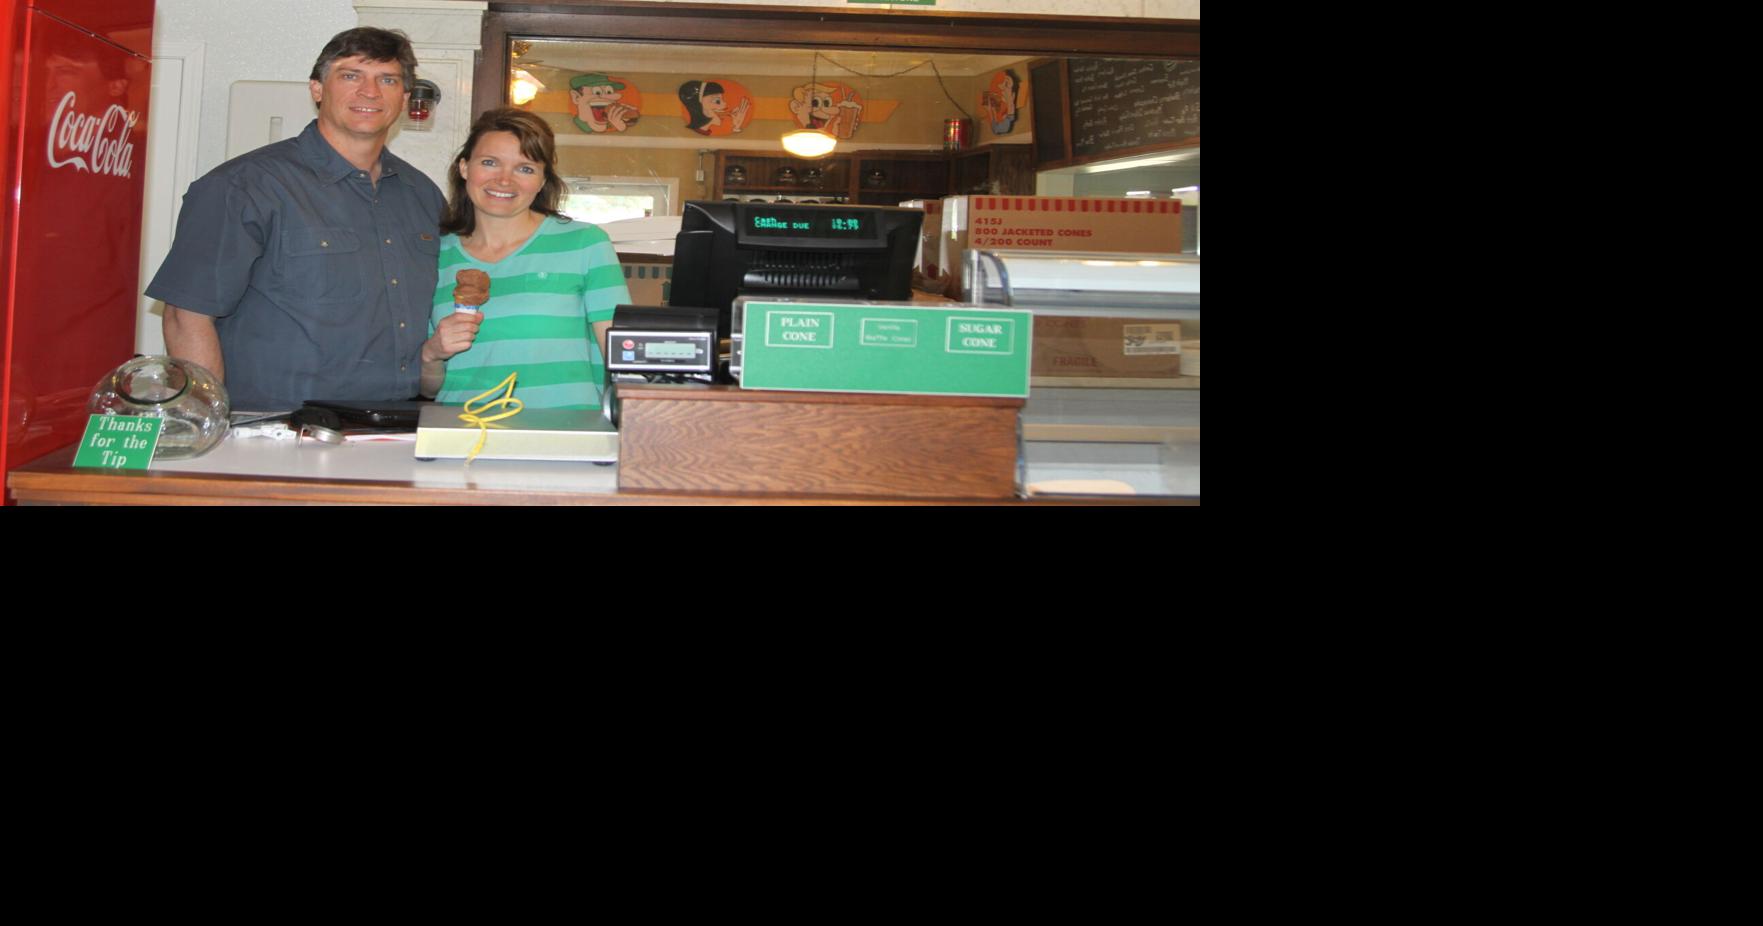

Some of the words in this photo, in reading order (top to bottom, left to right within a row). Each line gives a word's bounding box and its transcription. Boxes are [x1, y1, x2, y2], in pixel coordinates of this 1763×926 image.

[47, 90, 140, 179] Coca-Cola
[792, 222, 810, 230] DUE
[974, 217, 1002, 225] 415J
[974, 227, 998, 235] 800
[1001, 227, 1054, 237] JACKETED
[1057, 229, 1093, 238] CONES
[974, 238, 1013, 247] 4/200
[1016, 238, 1053, 247] COUNT
[780, 316, 820, 328] PLAIN
[958, 322, 1003, 335] SUGAR
[782, 331, 817, 342] CONE
[961, 337, 998, 349] CONE
[98, 415, 153, 433] Thanks
[89, 432, 115, 448] for
[123, 434, 148, 449] the
[101, 450, 127, 469] Tip
